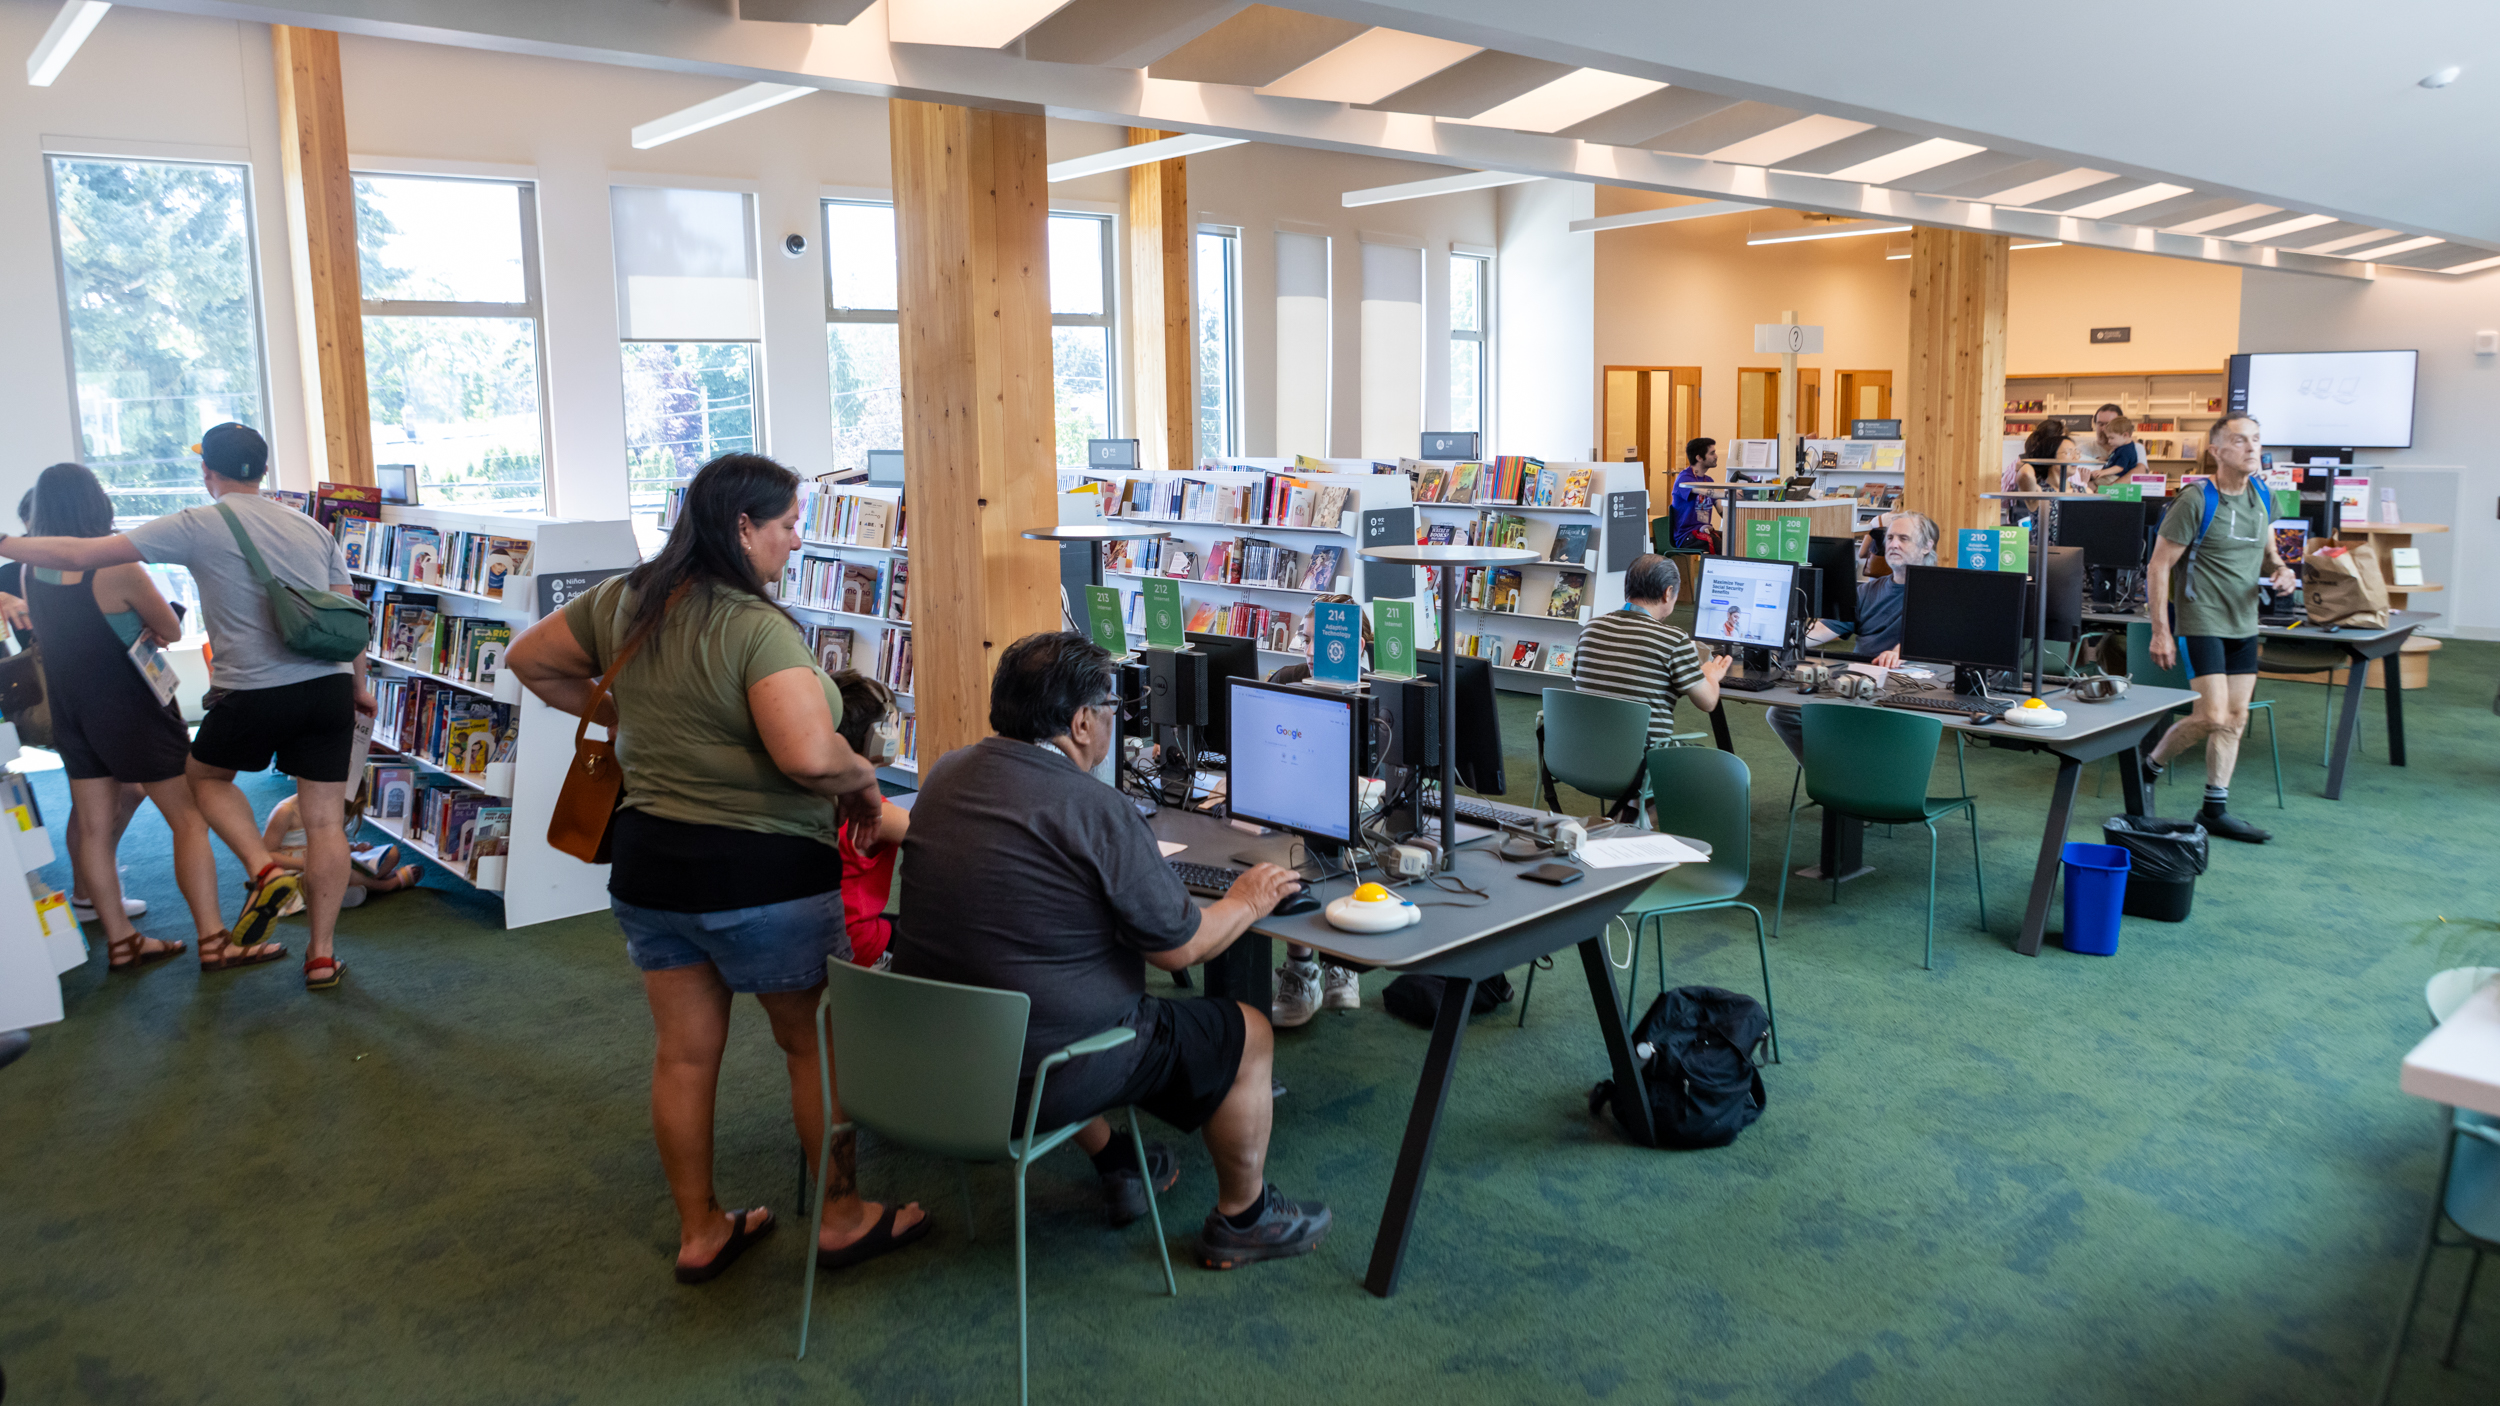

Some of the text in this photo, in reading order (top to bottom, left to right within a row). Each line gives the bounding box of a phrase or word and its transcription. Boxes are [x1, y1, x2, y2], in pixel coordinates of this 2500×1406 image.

[1970, 533, 1987, 541] 210
[1154, 584, 1168, 594] 212
[1096, 592, 1110, 603] 213
[1328, 610, 1345, 622] 214
[1386, 608, 1400, 618] 211
[1322, 630, 1351, 639] Technology
[1276, 724, 1302, 740] Google
